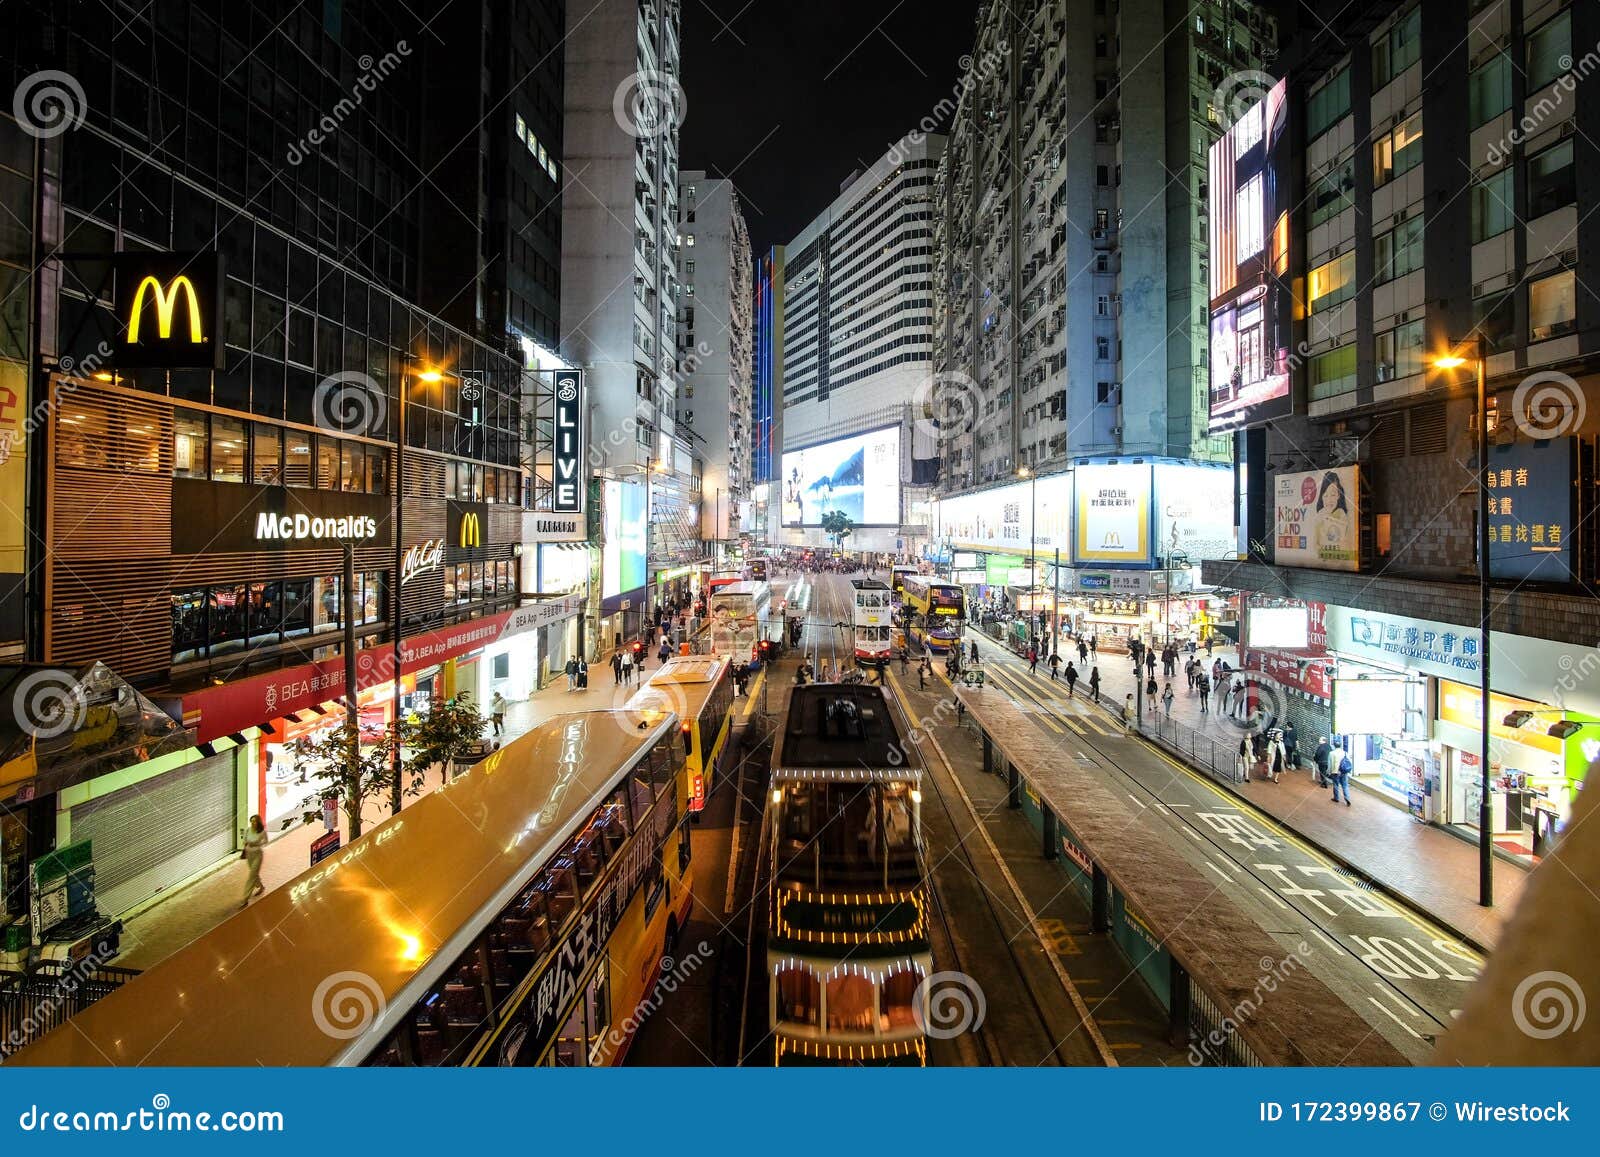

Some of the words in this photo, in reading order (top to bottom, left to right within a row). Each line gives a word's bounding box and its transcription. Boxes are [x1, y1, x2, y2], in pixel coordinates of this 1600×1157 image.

[558, 406, 576, 505] LIVE
[256, 512, 377, 540] McDonald's
[1279, 523, 1301, 535] LAND
[402, 539, 444, 577] McCafé
[516, 615, 527, 628] BEA
[434, 642, 446, 655] App
[1384, 642, 1399, 653] THE
[1400, 644, 1449, 664] COMMERCIAL
[1451, 656, 1478, 670] PRESS
[281, 680, 309, 701] BEA
